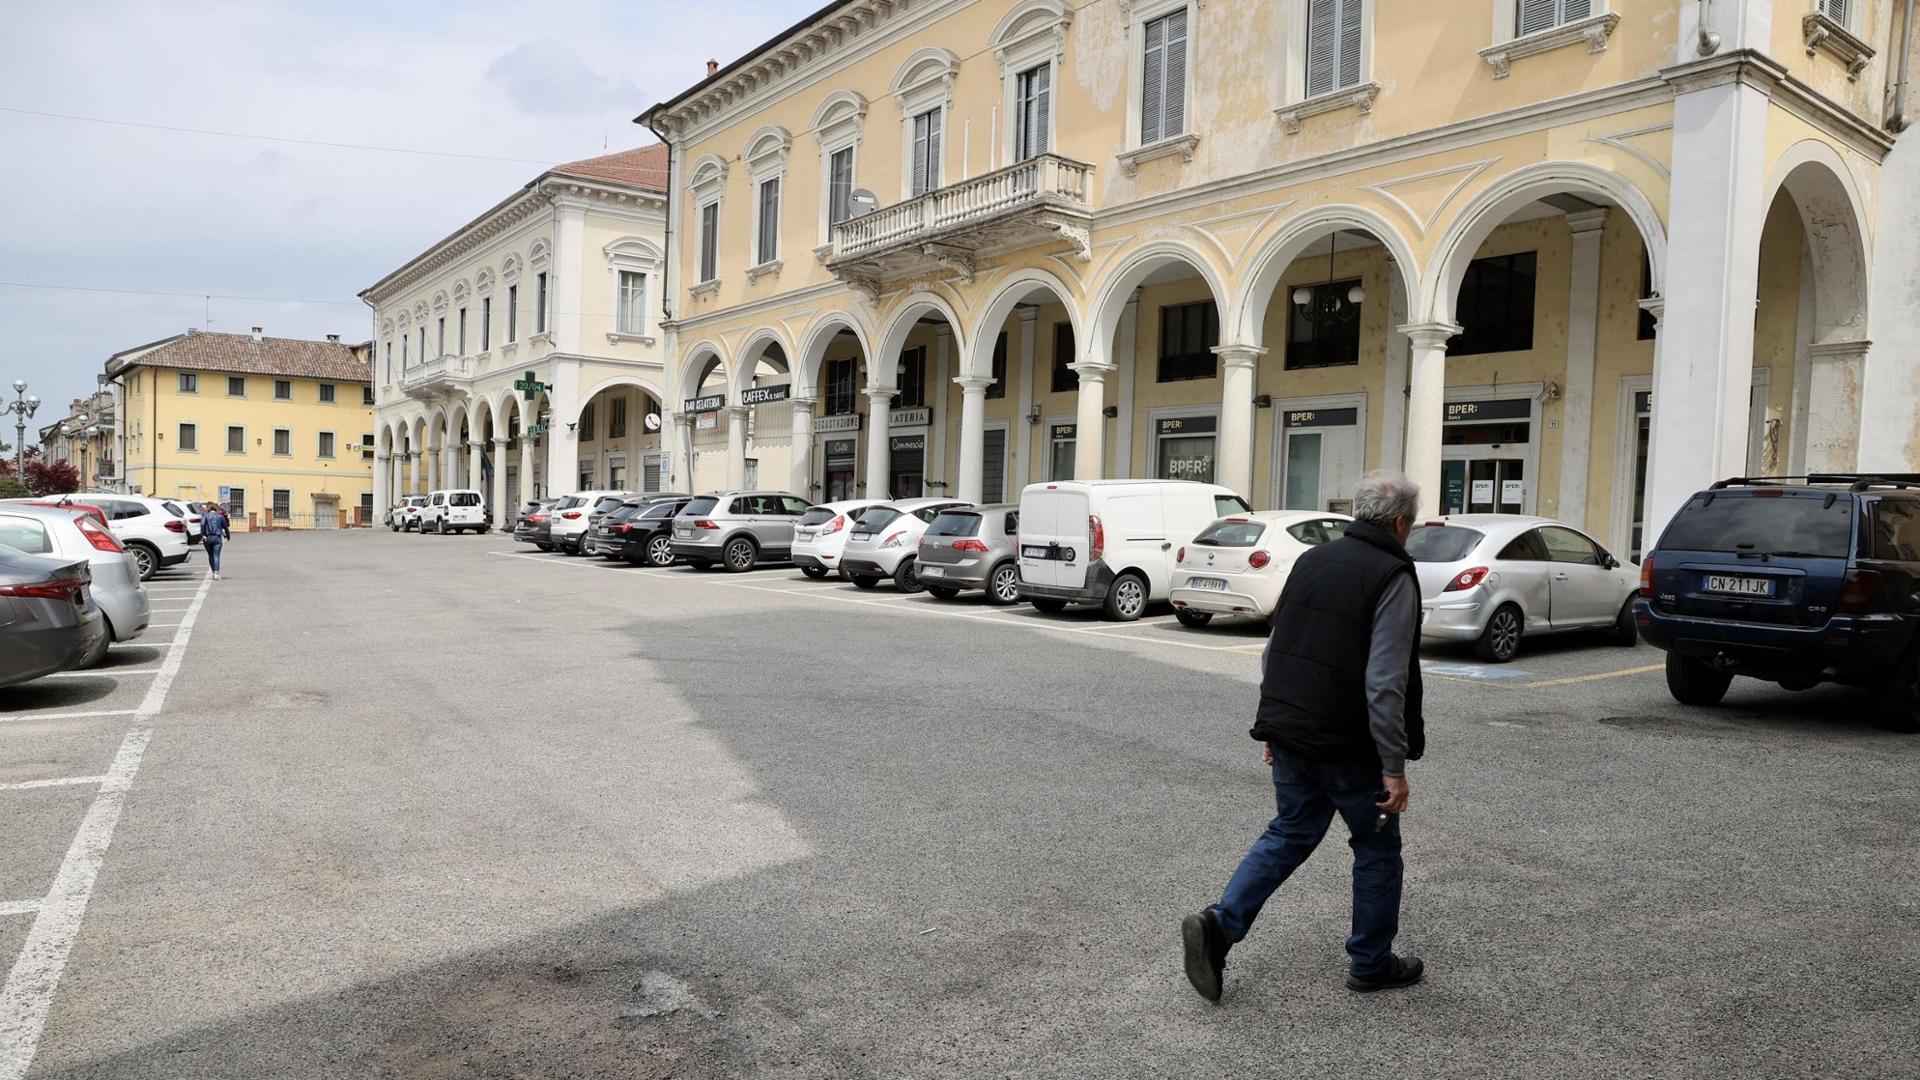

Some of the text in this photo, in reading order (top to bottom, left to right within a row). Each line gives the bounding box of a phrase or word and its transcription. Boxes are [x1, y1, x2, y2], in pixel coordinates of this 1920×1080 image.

[743, 389, 769, 403] CAFFEX
[696, 397, 720, 409] GELATERIA
[888, 413, 924, 424] LATERIA
[892, 439, 924, 450] Commercio
[1729, 579, 1767, 594] 211JK
